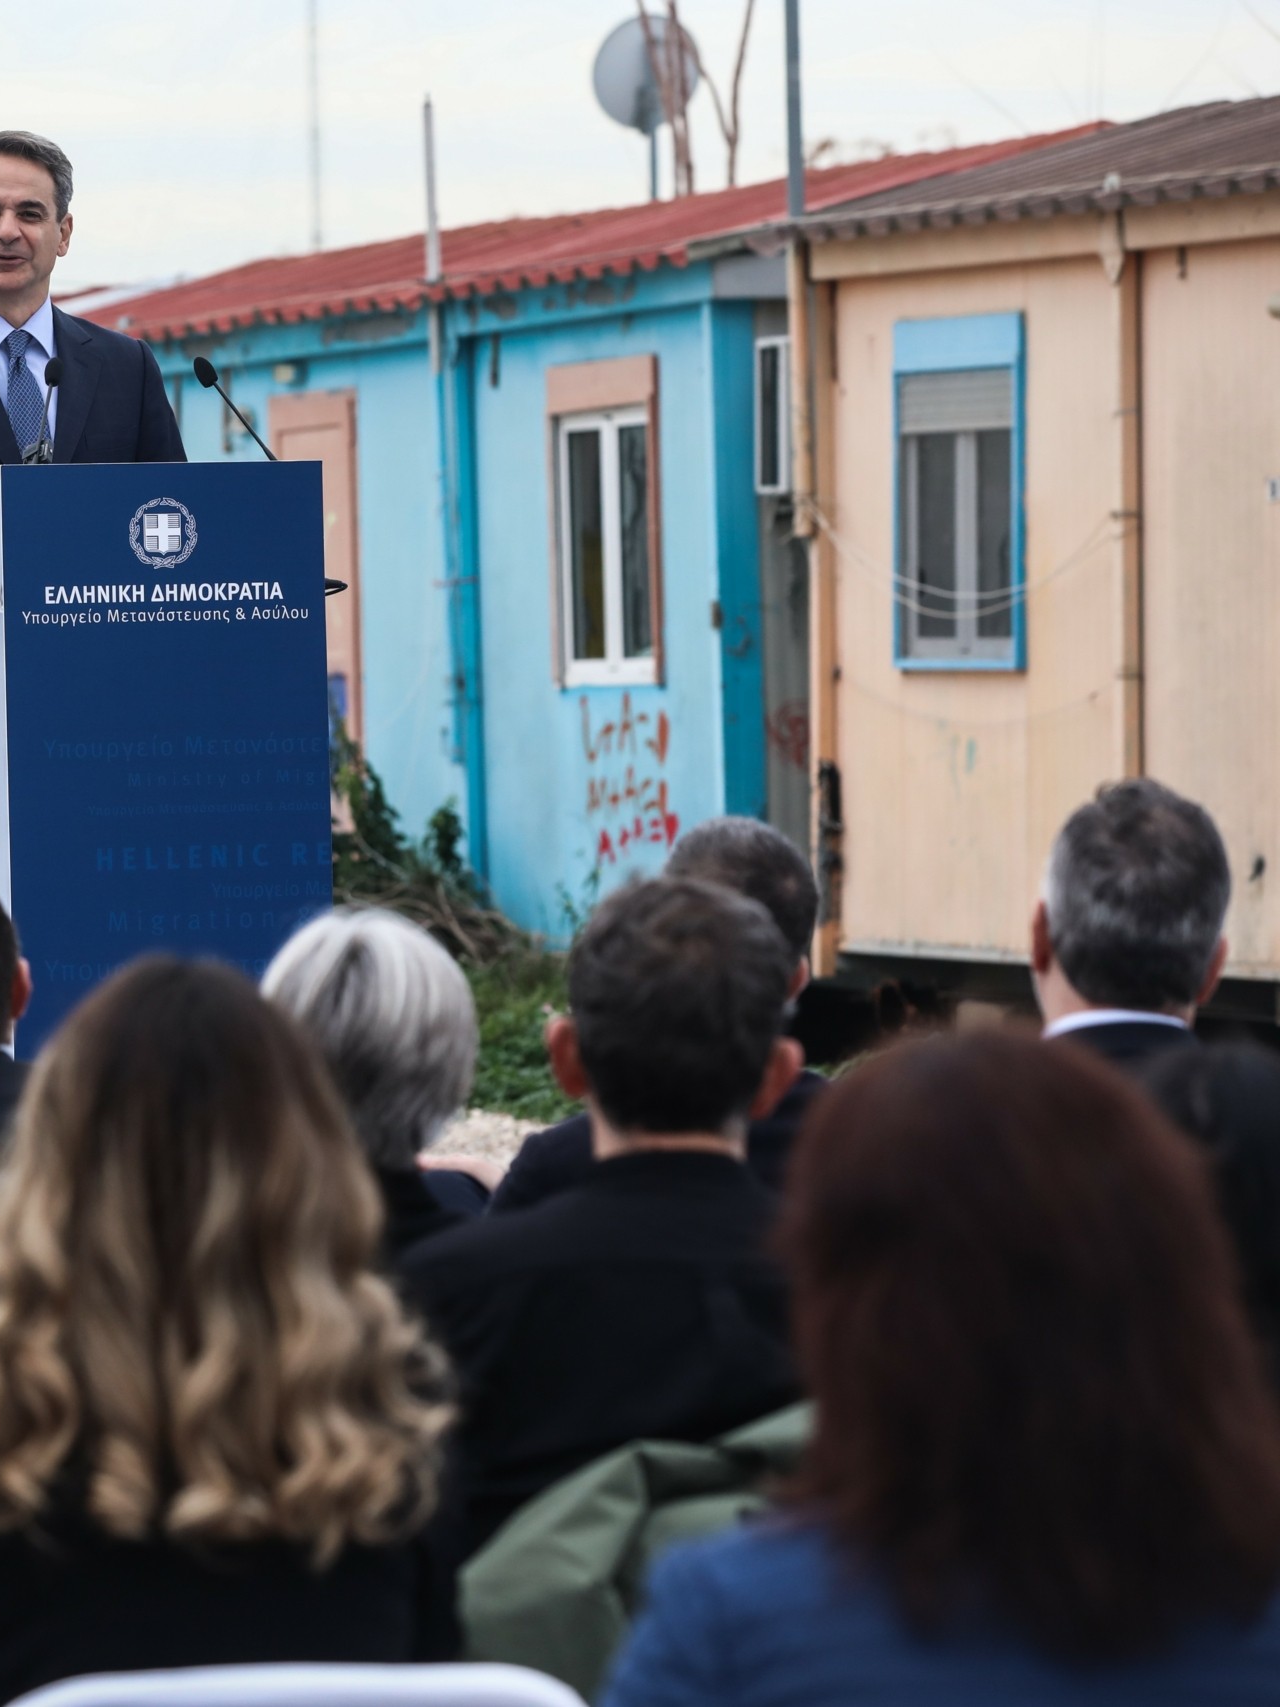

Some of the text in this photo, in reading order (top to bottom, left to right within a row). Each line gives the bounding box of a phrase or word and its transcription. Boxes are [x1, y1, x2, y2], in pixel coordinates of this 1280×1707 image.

[44, 581, 283, 604] ΕΛΛΗΝΙΚΗ ΔΗΜΟΚΡΑΤΙΑ
[22, 604, 309, 627] Υπουργείο Μετανάστευσης & Ασύλου
[43, 731, 327, 762] Υπουργείο Μετανάστε
[127, 771, 227, 788] Ministry
[96, 843, 269, 871] HELLENIC
[211, 880, 299, 901] Υπουργείο
[108, 910, 275, 935] Migration
